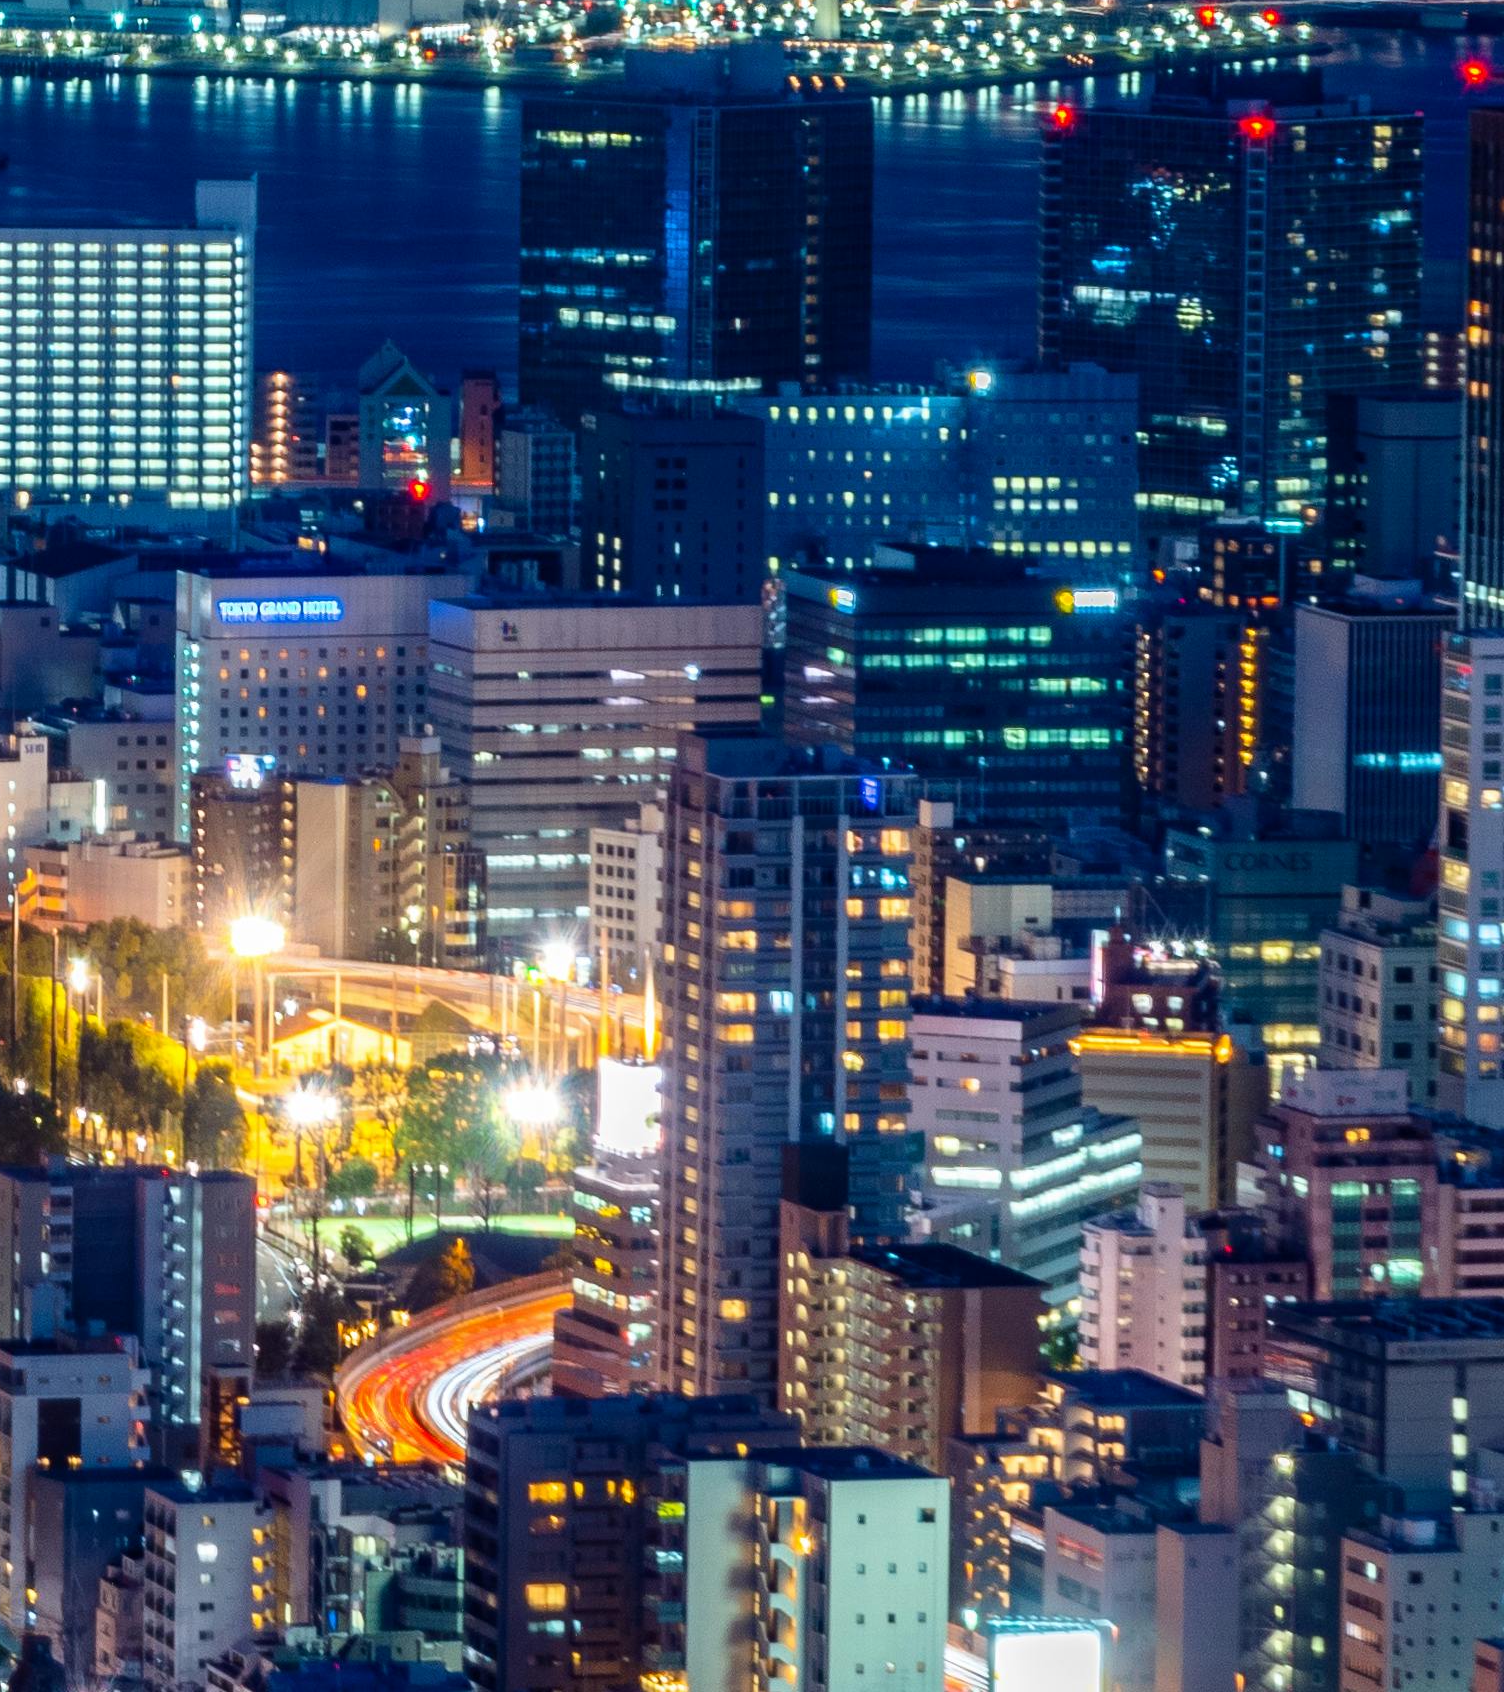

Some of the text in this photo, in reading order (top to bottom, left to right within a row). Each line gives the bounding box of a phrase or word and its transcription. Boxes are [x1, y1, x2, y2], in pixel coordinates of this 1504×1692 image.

[219, 600, 341, 622] TOKYO GRAND HOTEL
